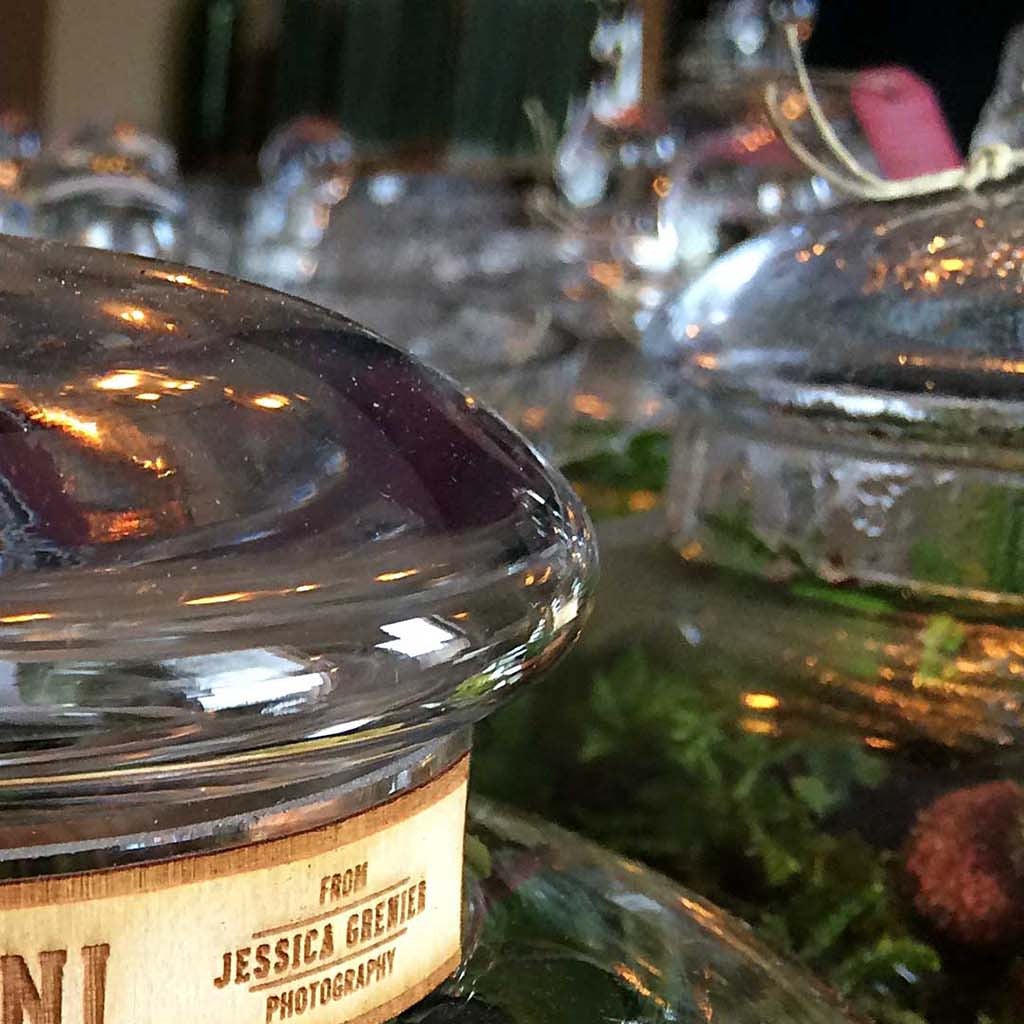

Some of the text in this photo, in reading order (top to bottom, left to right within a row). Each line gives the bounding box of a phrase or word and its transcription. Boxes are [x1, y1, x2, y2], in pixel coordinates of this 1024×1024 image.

[319, 861, 368, 906] FROM
[213, 879, 427, 989] JESSICA GRENIER
[265, 946, 397, 1024] PHOTOGRAPHY
